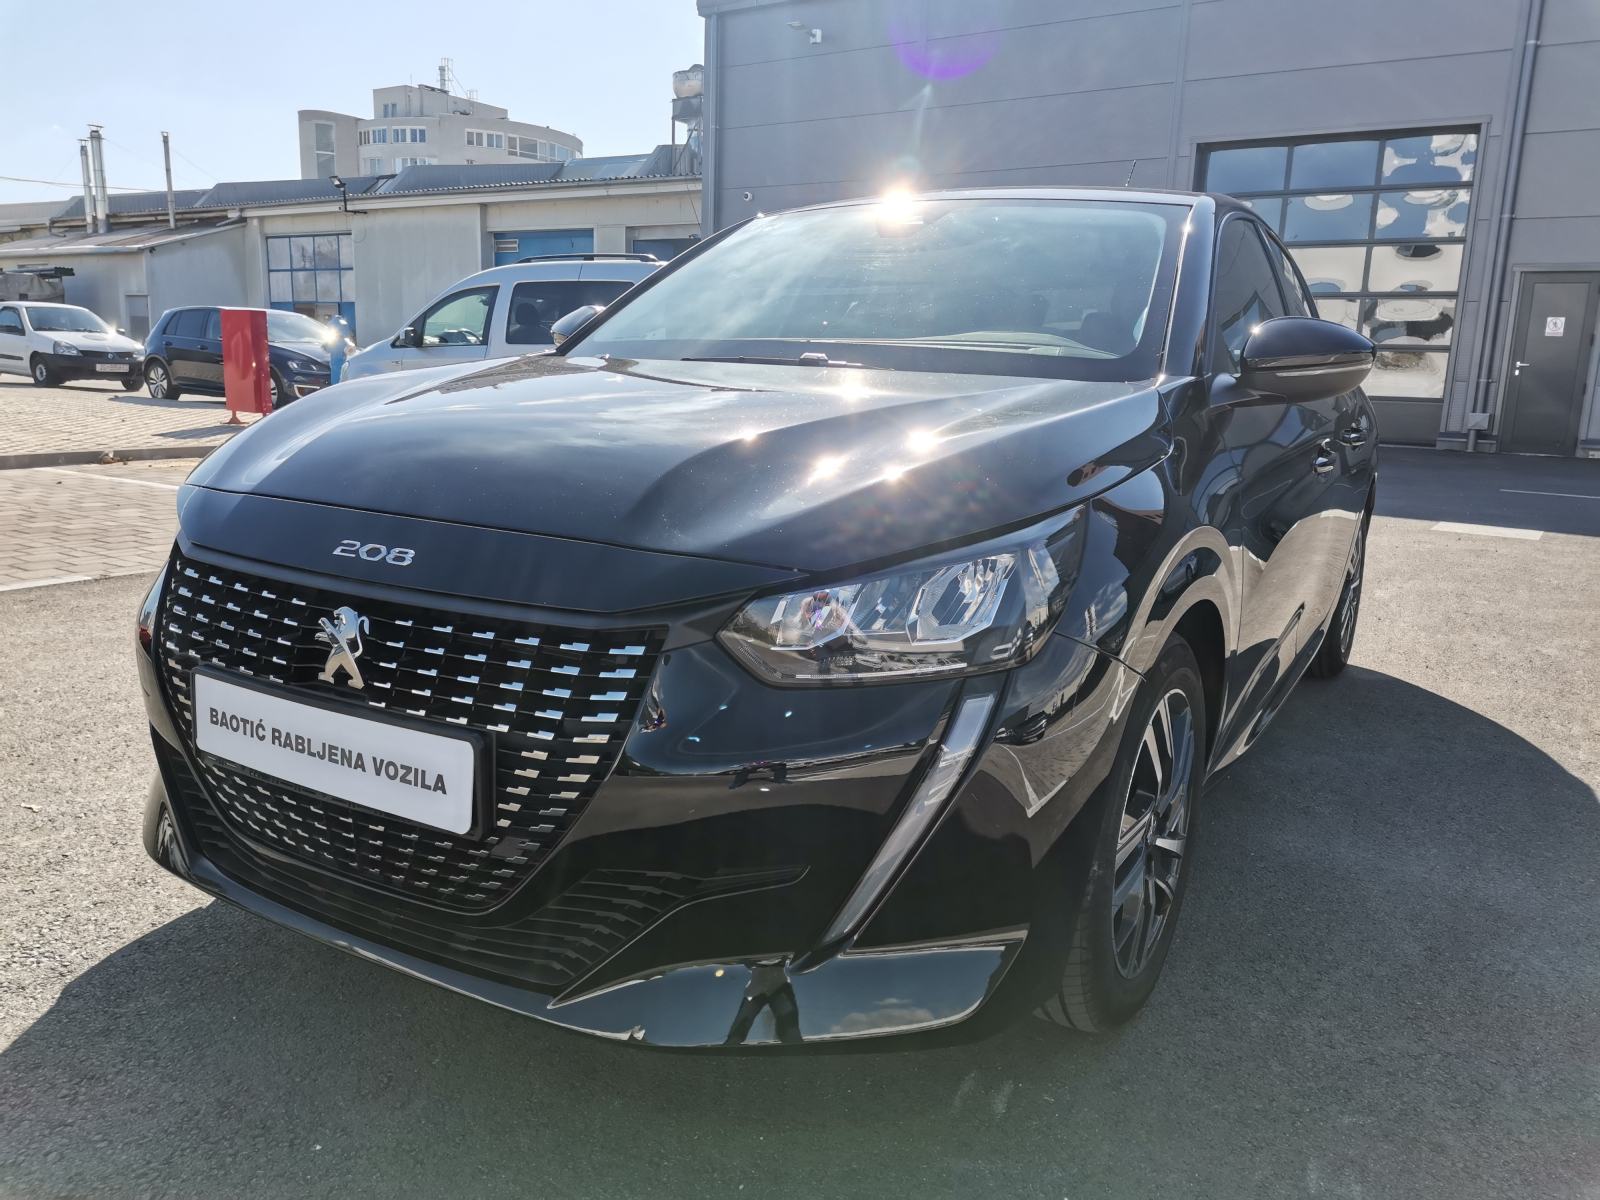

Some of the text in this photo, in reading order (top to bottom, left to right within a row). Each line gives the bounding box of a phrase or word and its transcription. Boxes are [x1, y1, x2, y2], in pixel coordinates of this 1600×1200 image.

[332, 539, 416, 566] 208
[209, 707, 447, 795] BAOTIĆ RABLJENA VOZILA
